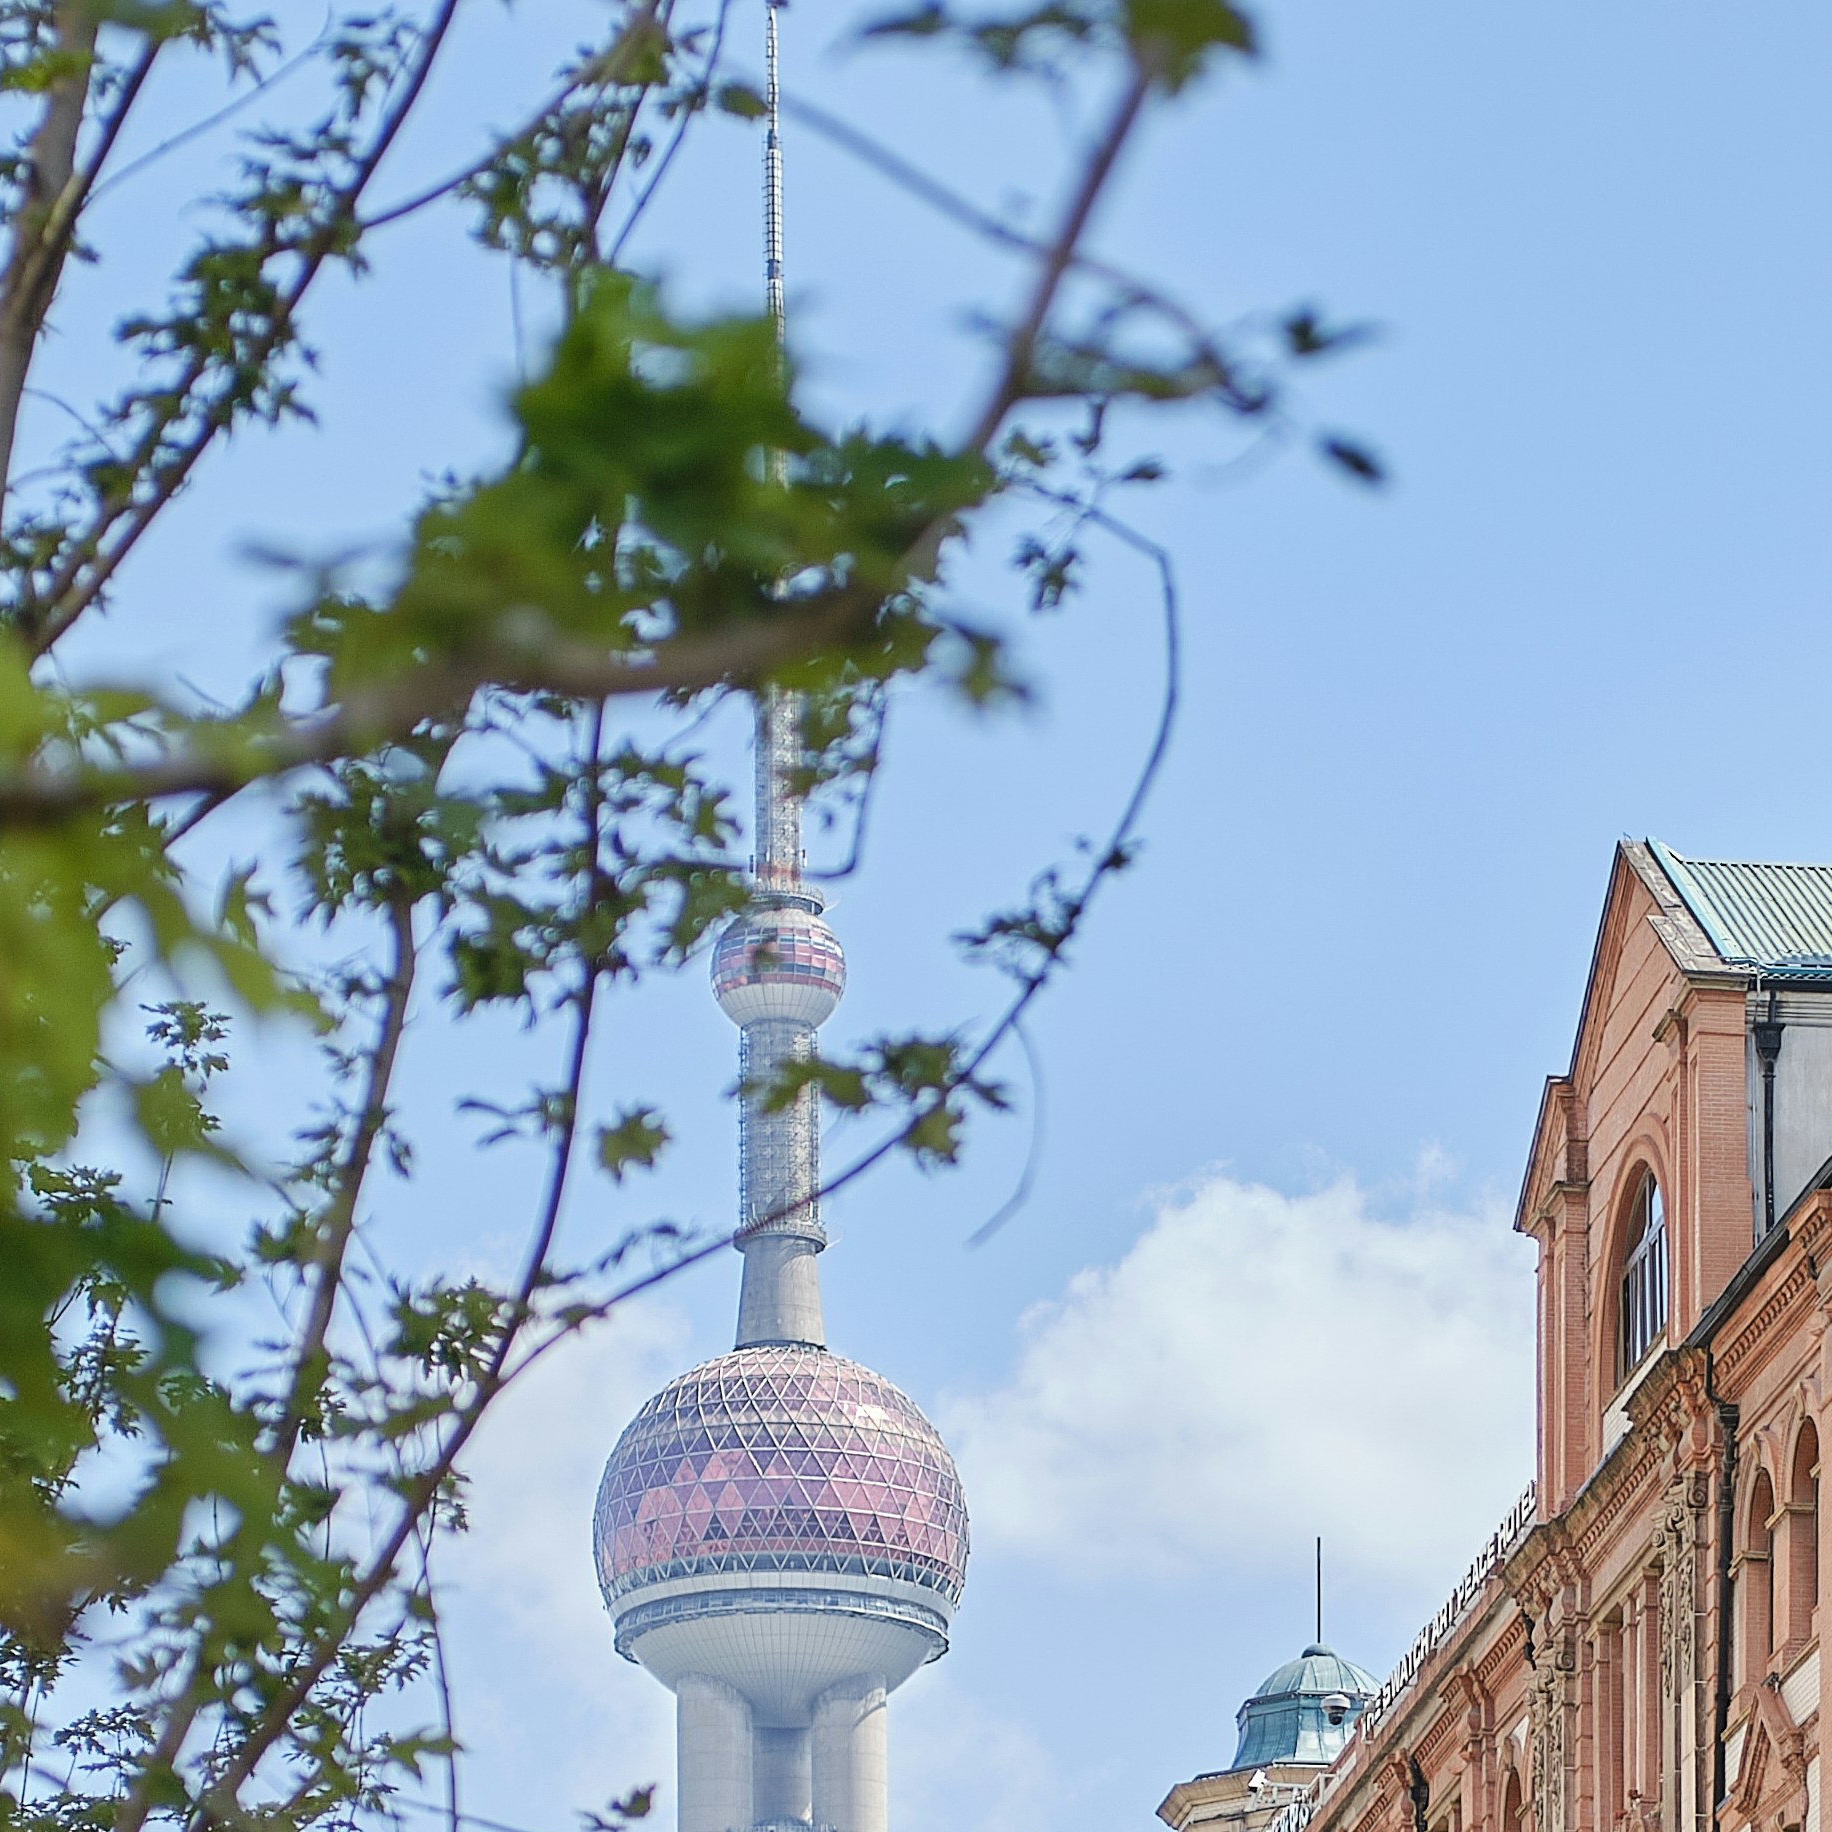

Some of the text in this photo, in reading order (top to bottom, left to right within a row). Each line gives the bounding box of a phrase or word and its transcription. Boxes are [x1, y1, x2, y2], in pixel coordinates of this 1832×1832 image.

[1382, 1624, 1431, 1711] SWATCH
[1429, 1598, 1456, 1650] ART
[1453, 1540, 1497, 1617] PEACE
[1496, 1479, 1537, 1556] HOTEL
